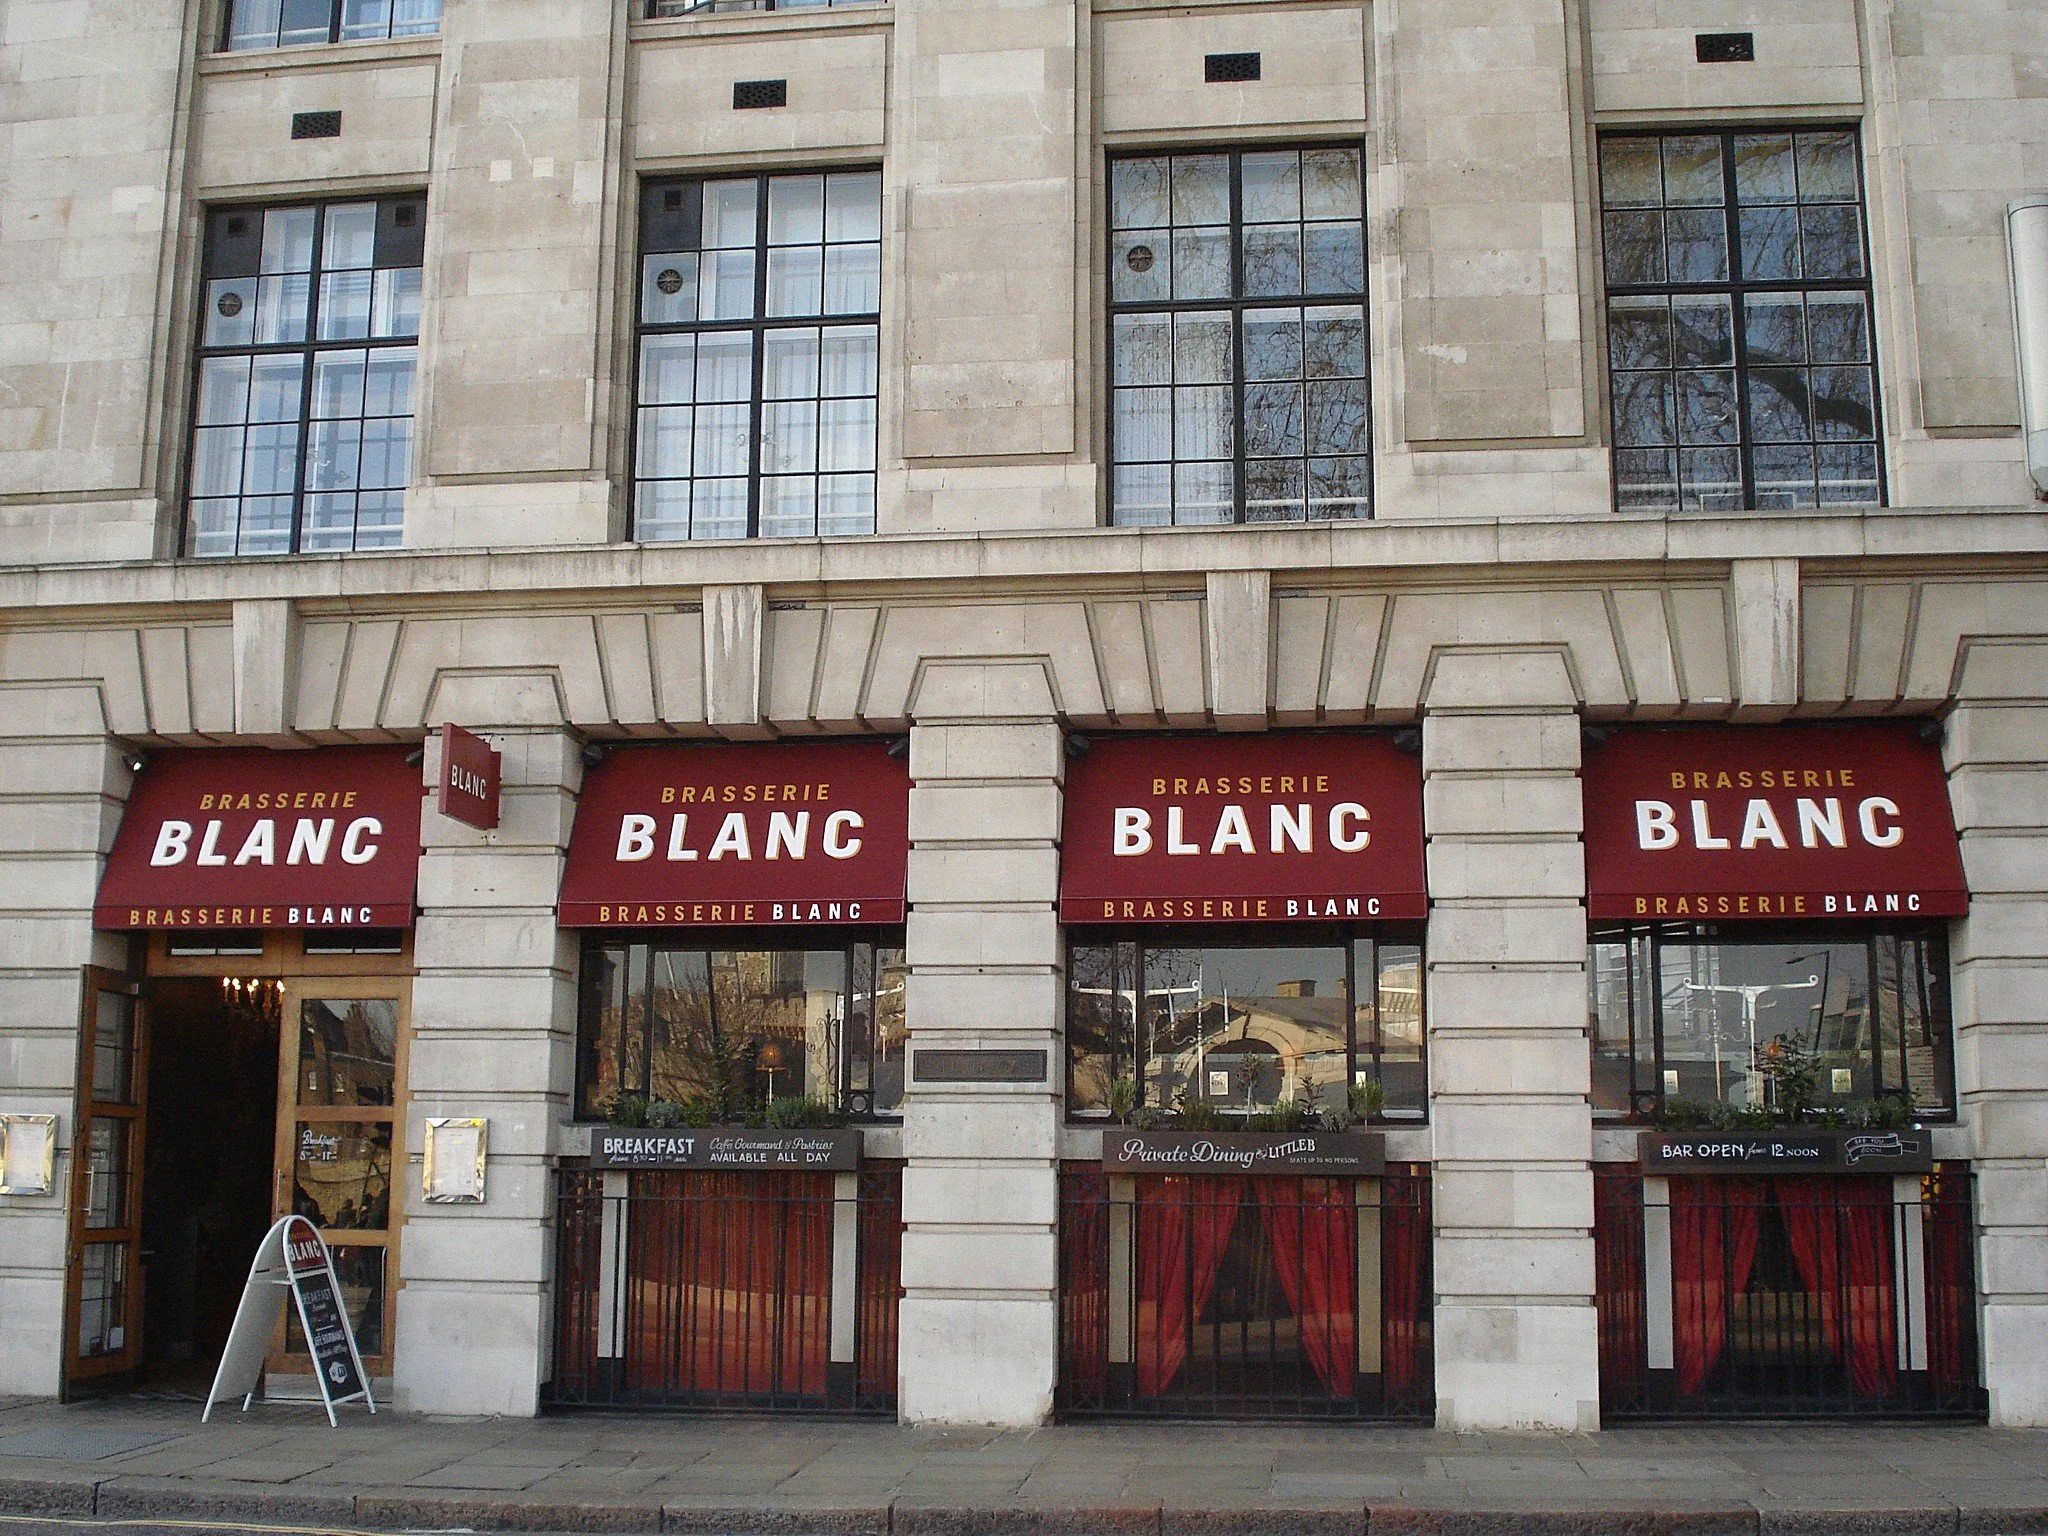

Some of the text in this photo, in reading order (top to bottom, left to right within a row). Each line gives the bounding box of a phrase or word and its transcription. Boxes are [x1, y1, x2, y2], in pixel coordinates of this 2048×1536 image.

[451, 764, 487, 800] BLANC
[1152, 775, 1329, 795] BRASSERIE
[1671, 769, 1855, 789] BRASSERIE
[199, 791, 357, 810] BRASSERIE
[661, 784, 830, 803] BRASSERIE
[1112, 802, 1372, 856] BLANC
[1635, 796, 1904, 850] BLANC
[150, 816, 384, 867] BLANC
[615, 810, 865, 862] BLANC
[599, 903, 862, 922] BRASSERIE BLANC
[1104, 897, 1381, 918] BRASSERIE BLANC
[1635, 893, 1921, 915] BRASSERIE BLANC
[129, 907, 373, 926] BRASSERIE BLANC
[603, 1138, 695, 1154] BREAKFAST
[734, 1138, 782, 1150] Gourmand
[792, 1138, 834, 1150] Pastries
[1118, 1138, 1188, 1162] Private
[1189, 1140, 1256, 1169] Dining
[1662, 1144, 1694, 1158] BAR
[1697, 1144, 1745, 1157] OPEN
[1771, 1143, 1784, 1157] 12
[1785, 1148, 1819, 1157] NOON
[709, 1152, 830, 1163] AVAILABLE ALL DAY
[288, 1240, 321, 1262] BLANC
